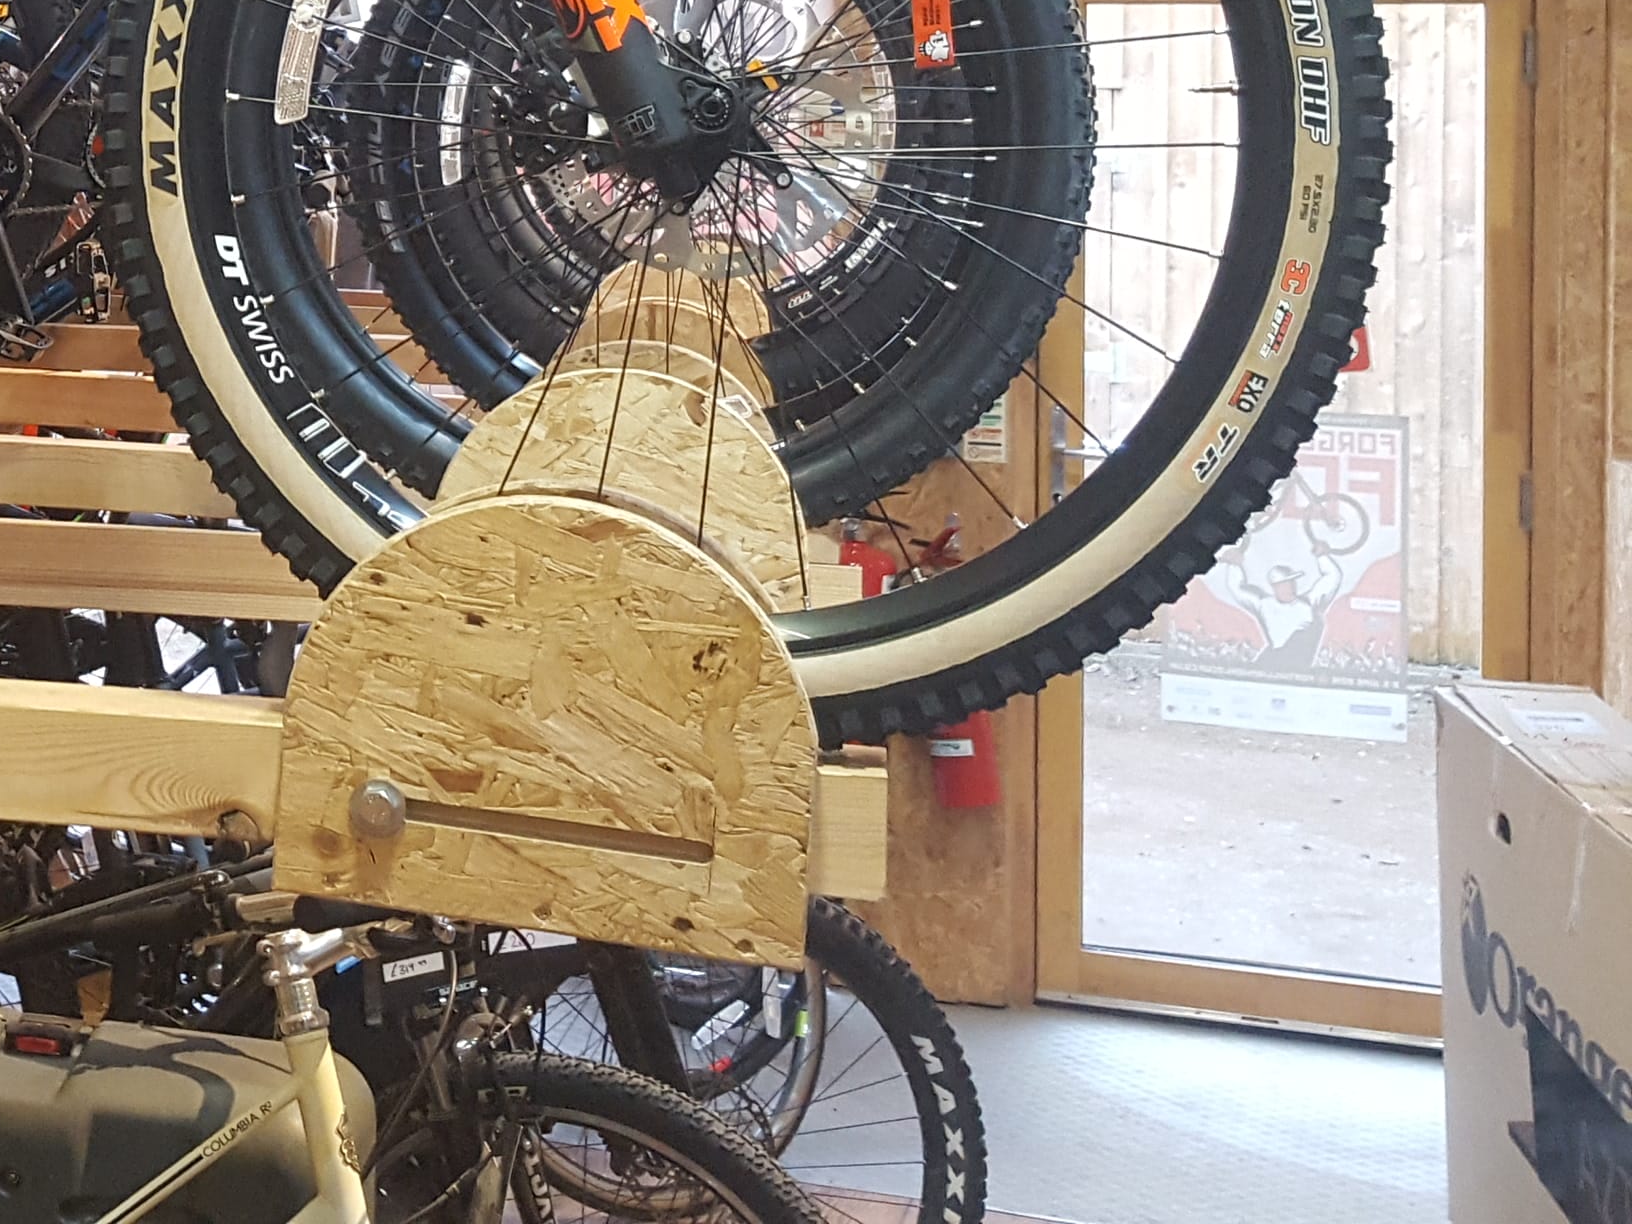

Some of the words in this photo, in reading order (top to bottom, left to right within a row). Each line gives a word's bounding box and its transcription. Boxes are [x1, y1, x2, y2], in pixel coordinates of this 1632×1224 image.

[1297, 56, 1330, 145] DHF
[1280, 259, 1311, 295] 3C
[213, 234, 249, 285] DT
[233, 295, 293, 385] SWISS
[1237, 374, 1268, 413] EXO
[1193, 424, 1240, 482] TR
[202, 1113, 259, 1158] COLUMBIA
